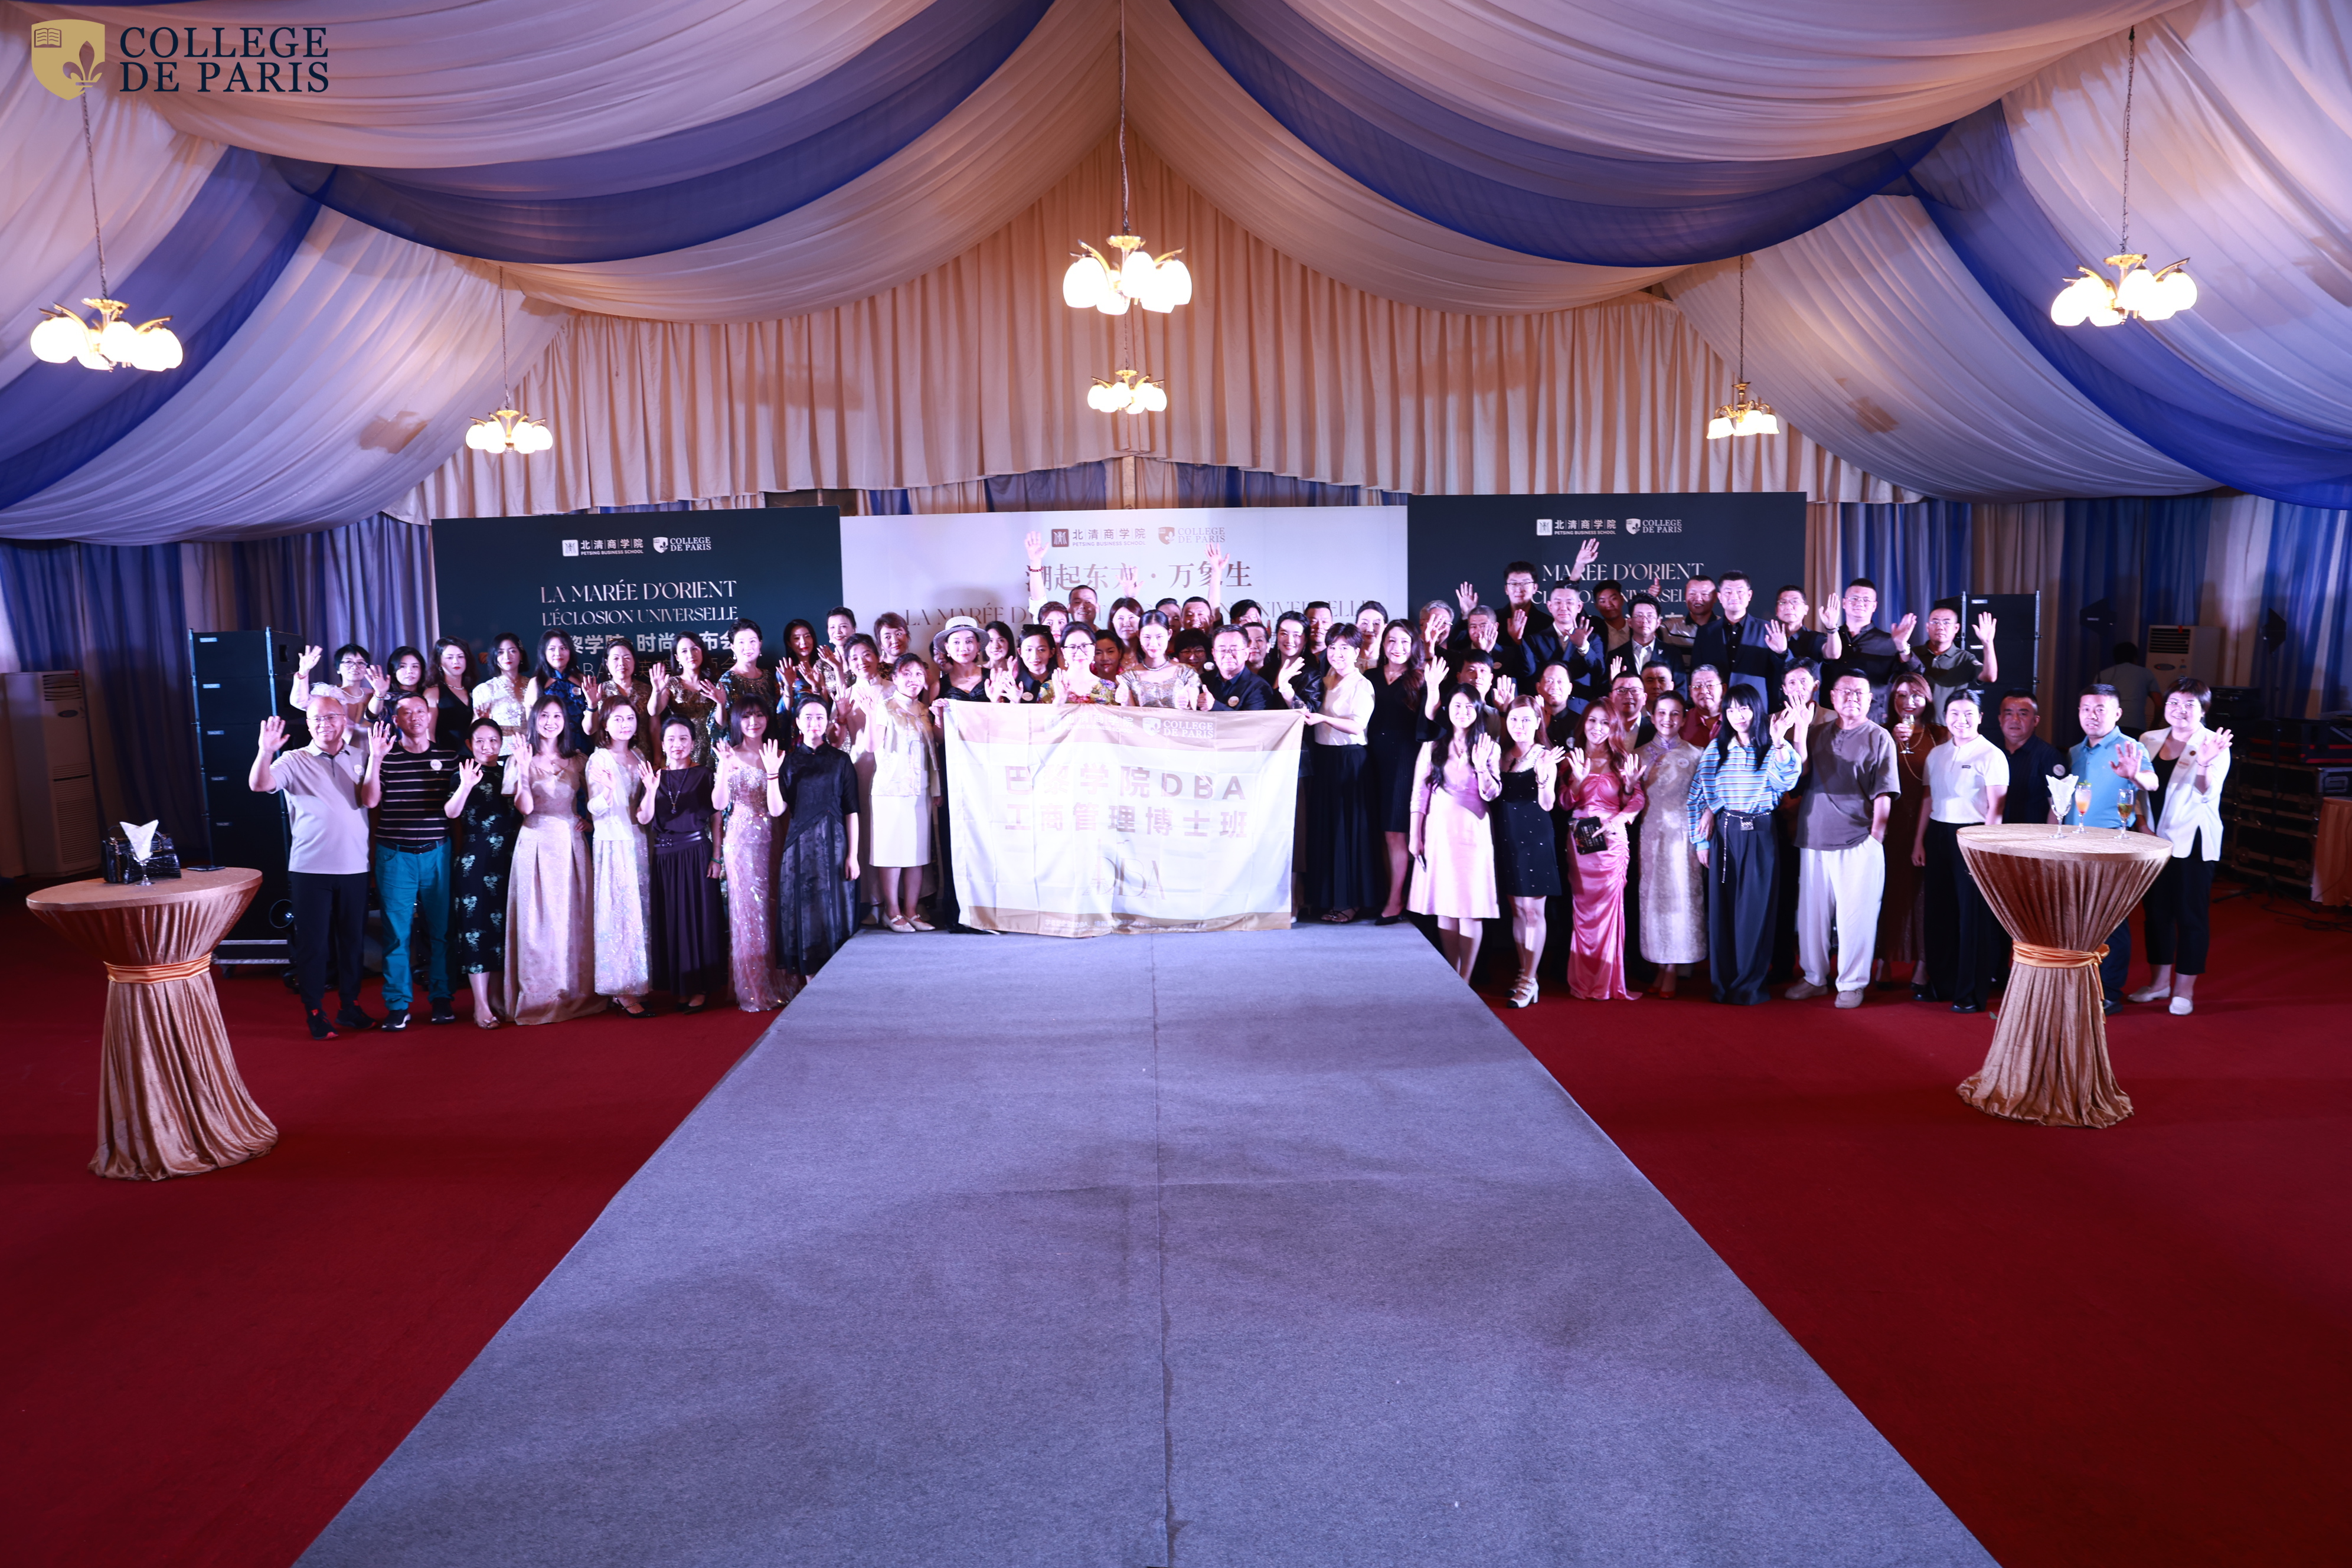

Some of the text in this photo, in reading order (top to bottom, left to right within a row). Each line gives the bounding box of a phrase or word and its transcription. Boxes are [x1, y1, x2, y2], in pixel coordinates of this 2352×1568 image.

[1178, 527, 1225, 535] COLLEGE
[669, 537, 711, 545] COLLEGE
[1195, 535, 1226, 543] PARIS
[1613, 563, 1704, 580] D'ORIENT
[541, 579, 737, 603] LA MARÉE D'ORIENT
[542, 606, 739, 626] L'ÉCLOSION UNIVERSELLE
[906, 609, 930, 626] LA
[1163, 720, 1214, 731] COLLEGE
[1164, 728, 1214, 739] DE PARIS
[1005, 801, 1247, 838] 工商管理博士班
